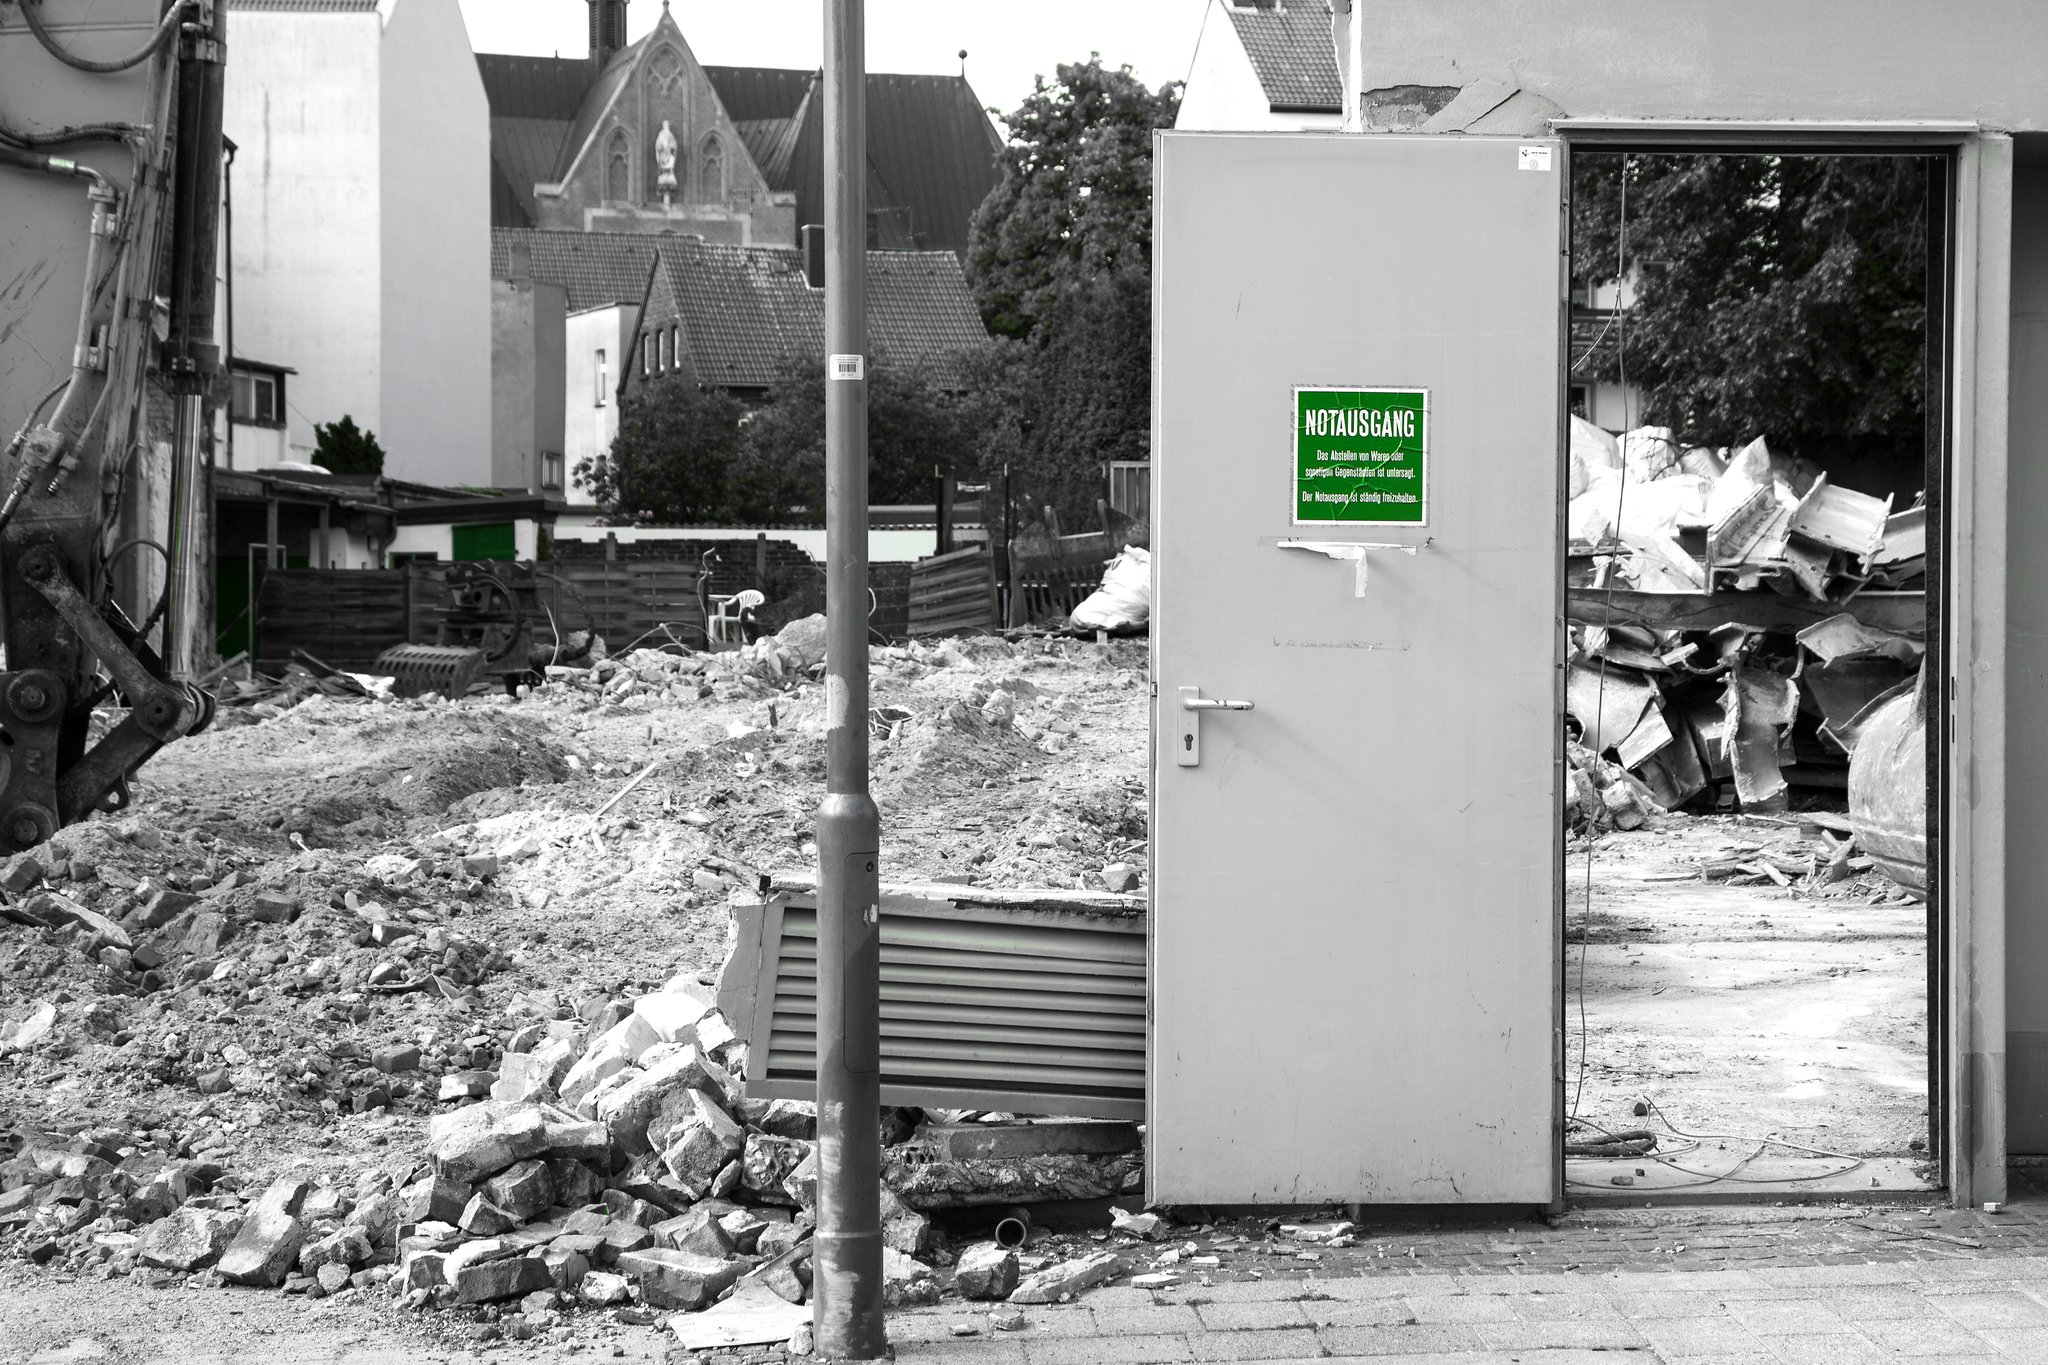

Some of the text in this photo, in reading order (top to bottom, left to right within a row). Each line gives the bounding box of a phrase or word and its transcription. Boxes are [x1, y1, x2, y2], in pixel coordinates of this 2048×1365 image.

[1305, 409, 1415, 438] NOTAUSGANG
[1316, 450, 1404, 462] Das Abstellen von Waren oder
[1377, 467, 1385, 477] ist
[1386, 468, 1416, 480] untersagt.
[1302, 491, 1313, 502] Der
[1315, 491, 1349, 504] Notausgang
[1359, 492, 1381, 504] ständig
